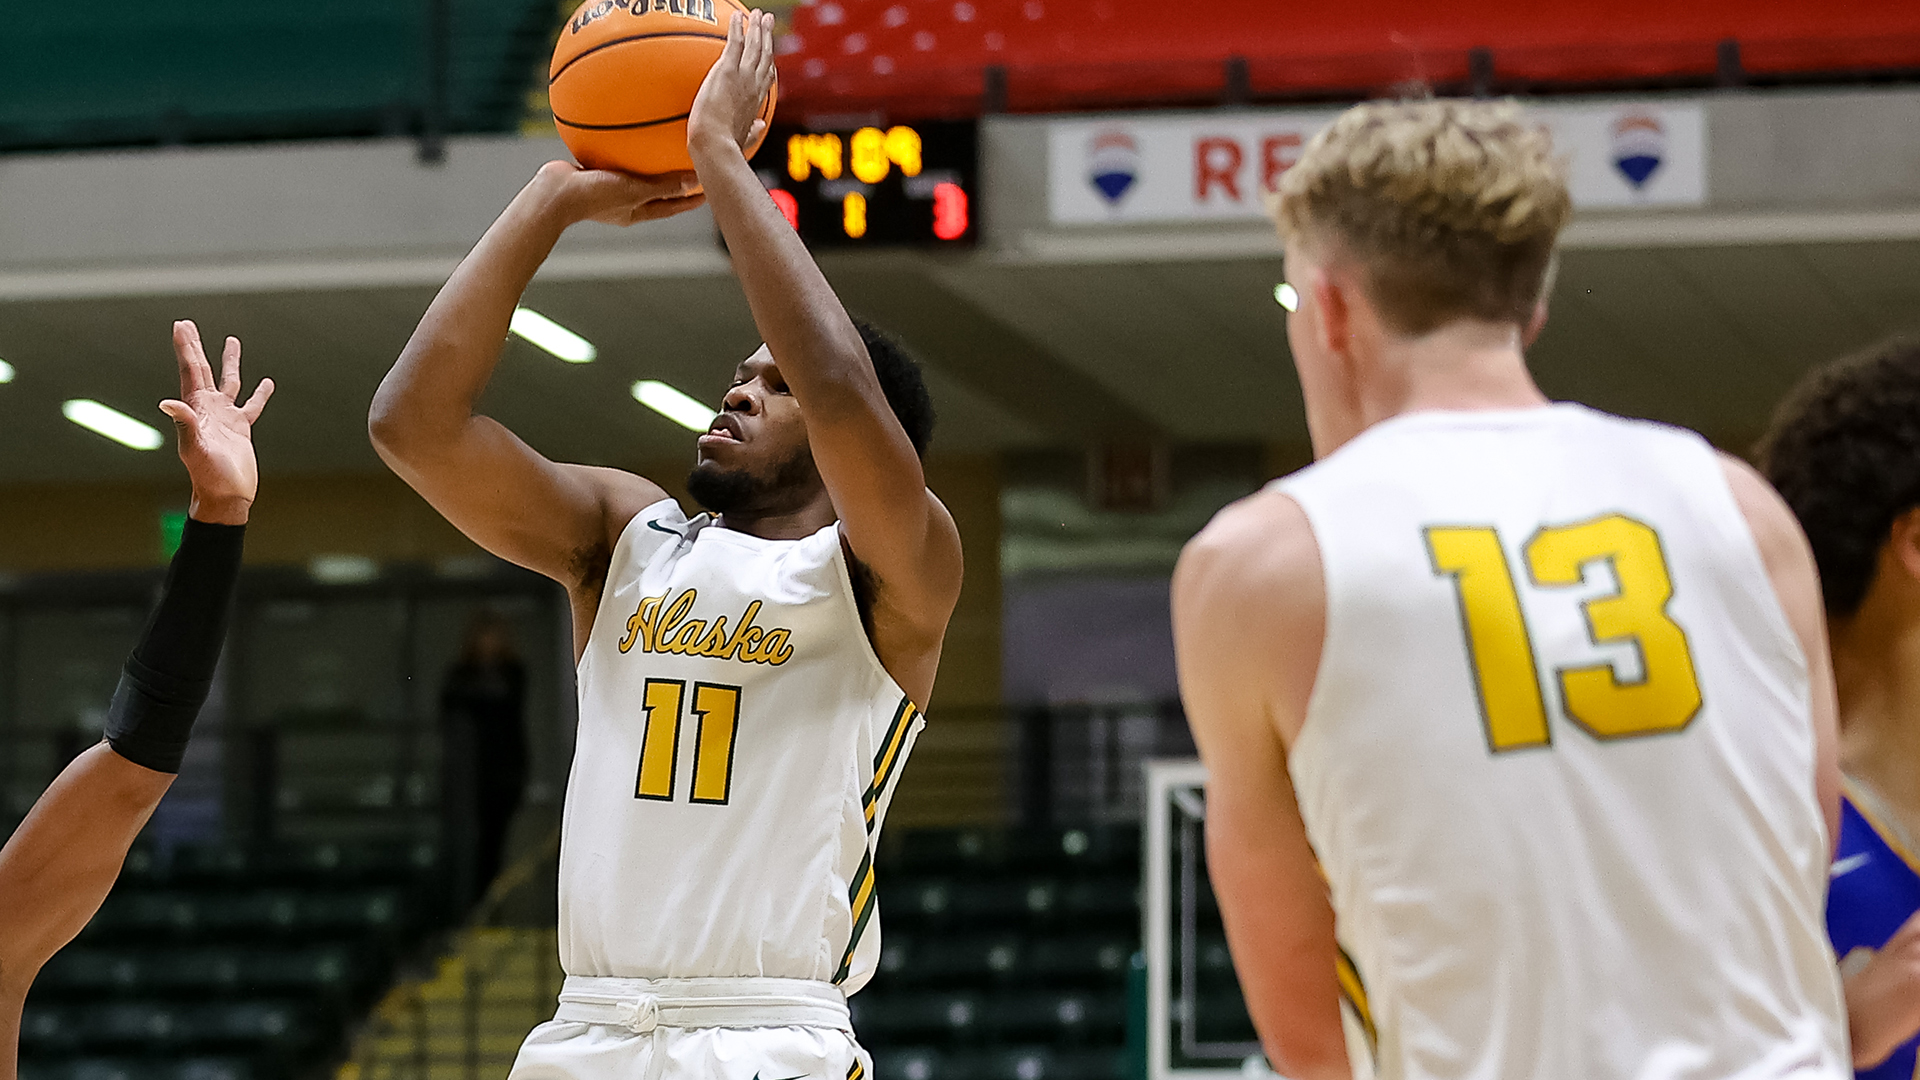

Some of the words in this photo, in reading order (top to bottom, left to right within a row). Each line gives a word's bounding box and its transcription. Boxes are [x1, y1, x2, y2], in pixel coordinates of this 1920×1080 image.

[619, 587, 795, 666] Alaska
[1421, 511, 1704, 754] 13
[634, 678, 742, 805] 11
